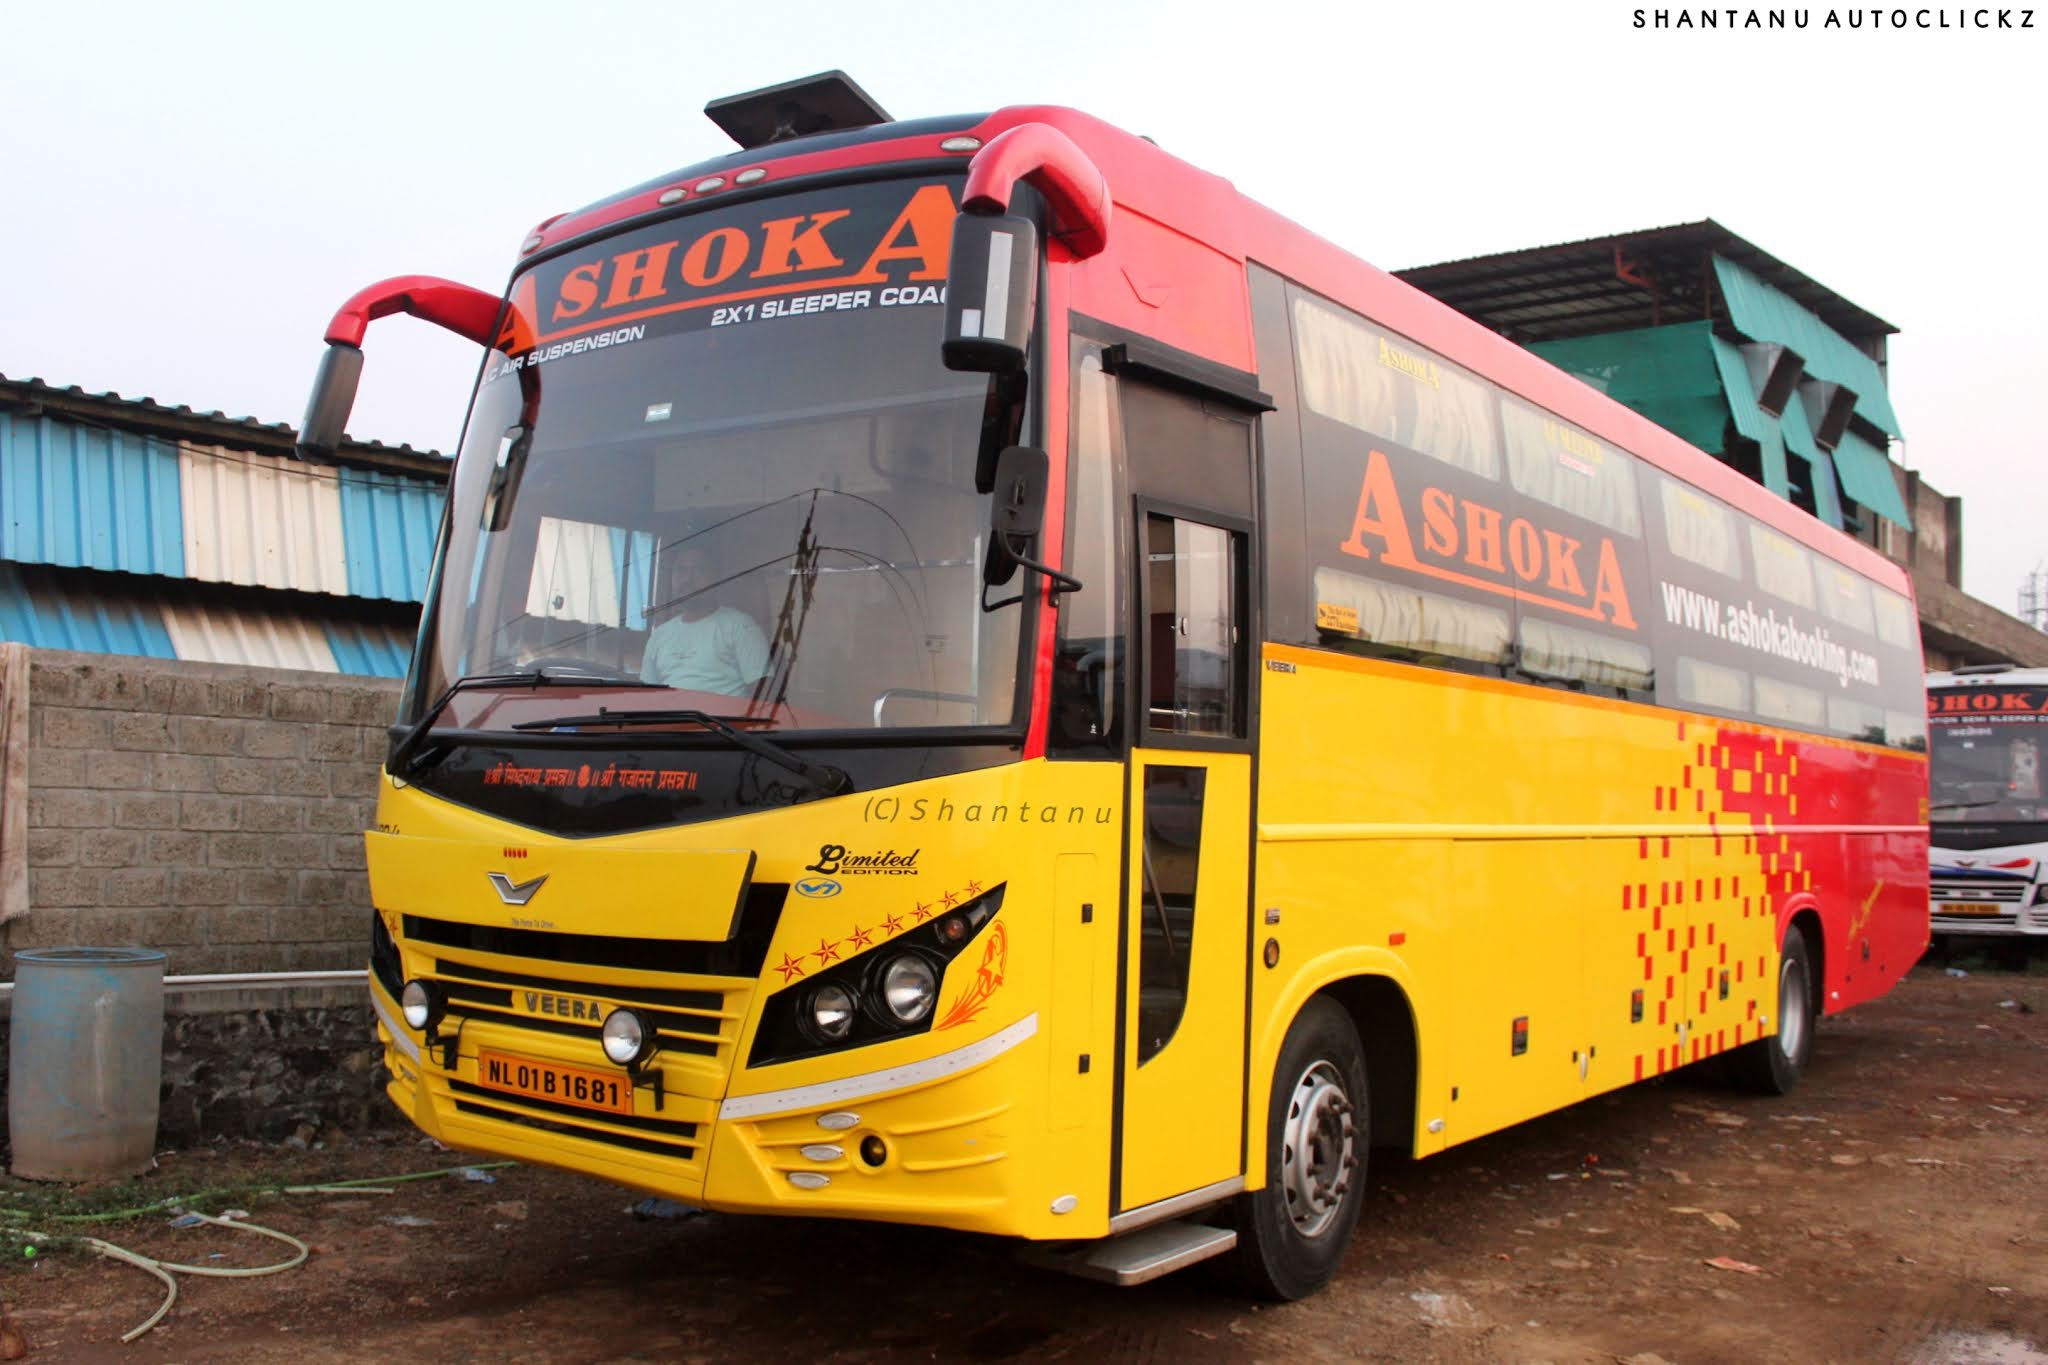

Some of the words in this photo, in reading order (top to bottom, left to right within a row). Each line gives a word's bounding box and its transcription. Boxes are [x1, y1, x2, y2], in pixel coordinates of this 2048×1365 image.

[487, 184, 957, 361] ASHOKA
[711, 304, 755, 326] 2X1
[761, 289, 871, 319] SLEEPER
[880, 285, 946, 306] COA
[500, 355, 524, 376] AIR
[527, 324, 646, 366] SUSPENSION
[1378, 336, 1440, 390] ASHOKA
[1340, 449, 1638, 630] ASHOKA
[1661, 581, 1879, 688] www.ashokabooking.com
[805, 844, 920, 874] Limited
[526, 992, 602, 1021] VEERA
